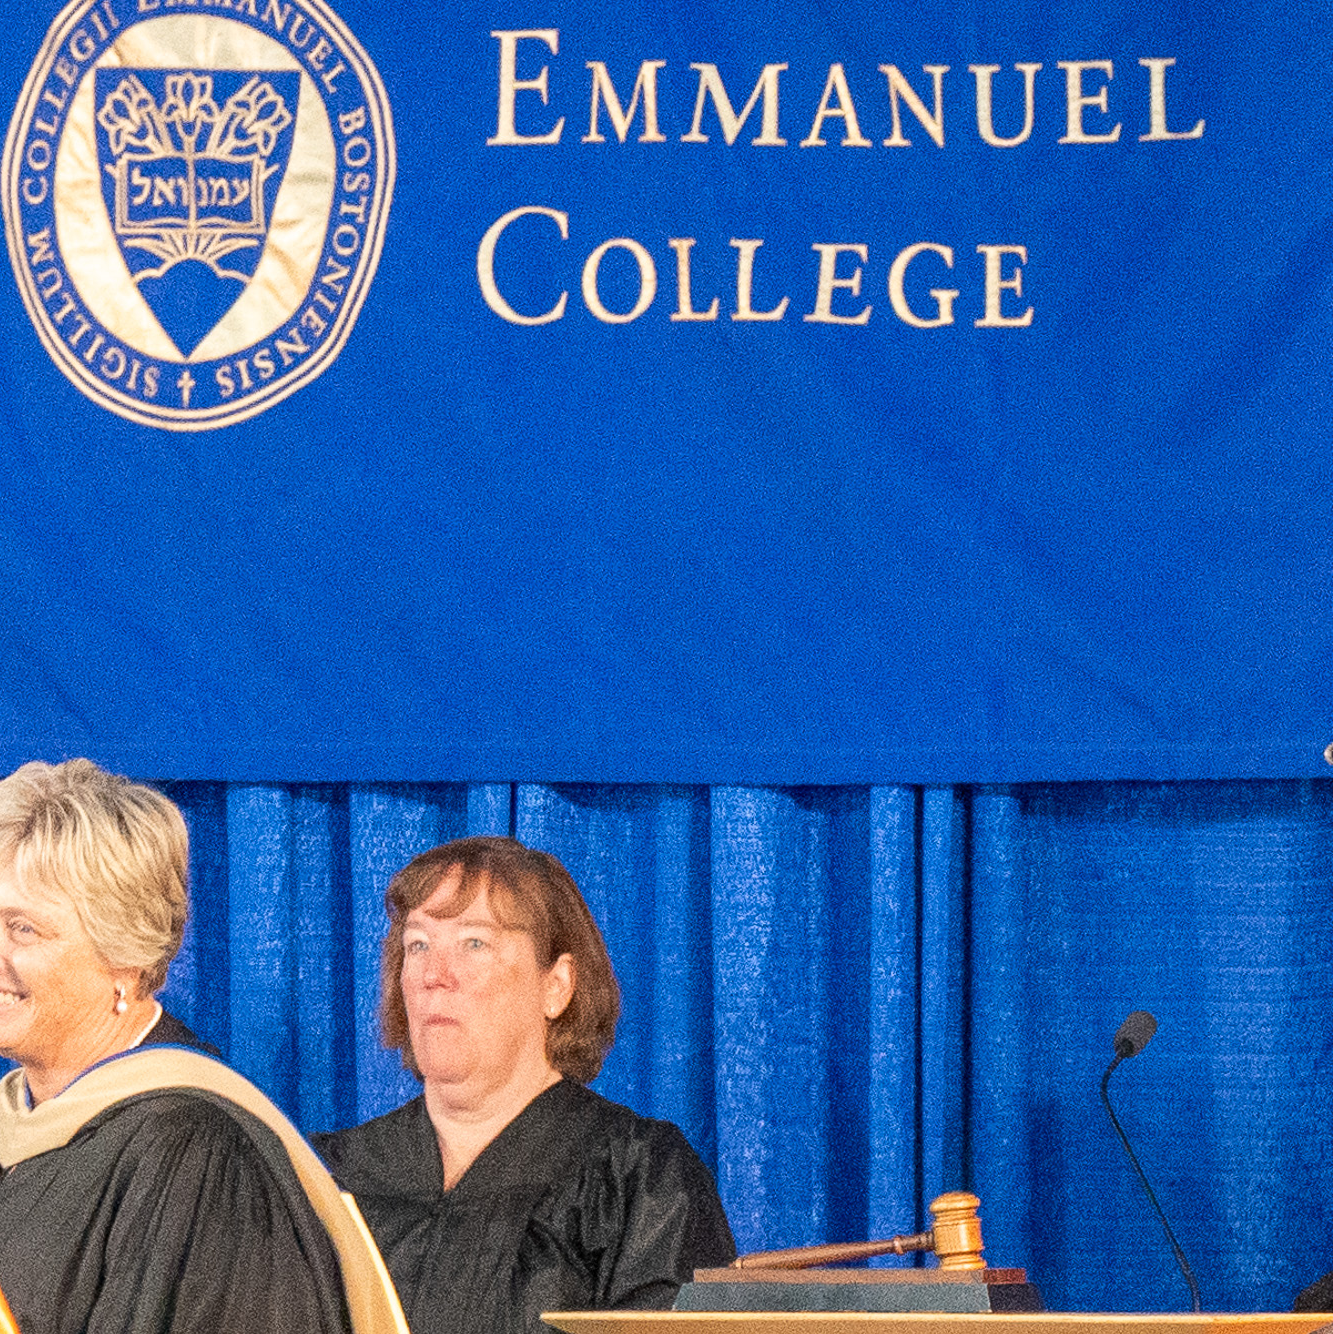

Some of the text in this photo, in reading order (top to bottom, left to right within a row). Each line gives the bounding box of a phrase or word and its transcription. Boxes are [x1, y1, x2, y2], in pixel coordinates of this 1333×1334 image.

[23, 0, 120, 203] COLLEGII
[486, 28, 1206, 149] EMMANUEL
[26, 227, 161, 396] SIGILLUM
[215, 105, 372, 398] BOSTONIENSIS
[476, 205, 1035, 329] COLLEGE
